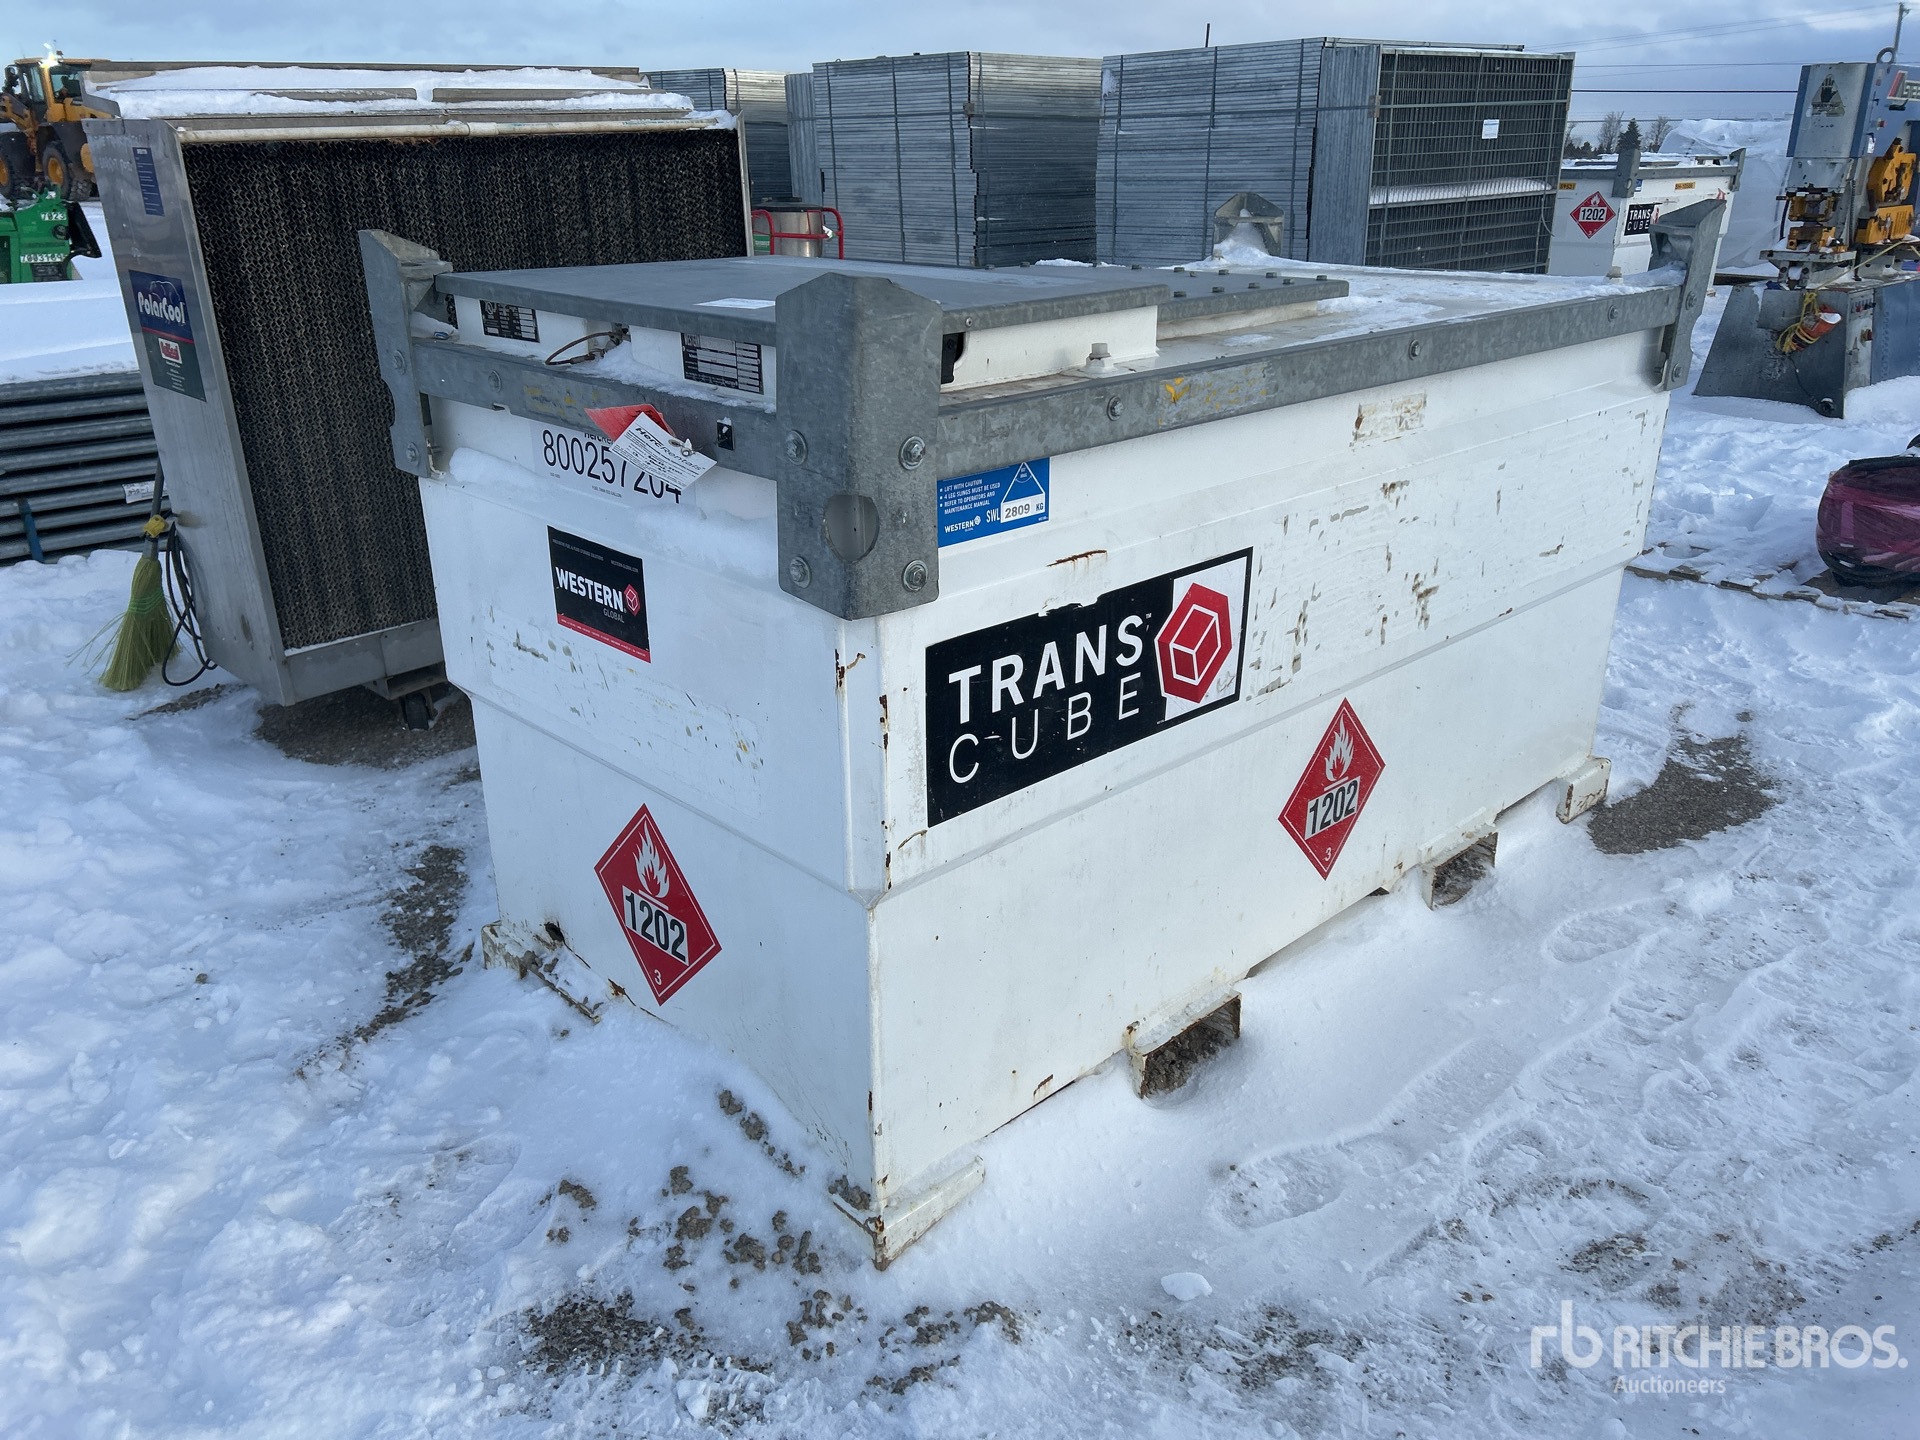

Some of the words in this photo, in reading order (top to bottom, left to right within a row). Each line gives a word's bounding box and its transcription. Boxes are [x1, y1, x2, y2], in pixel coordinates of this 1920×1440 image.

[1581, 208, 1605, 221] 1202
[1630, 209, 1651, 220] TRANS
[1627, 220, 1650, 231] CUBE
[137, 291, 185, 324] PolarCool
[986, 508, 1000, 523] SWL
[1004, 503, 1031, 519] 2809
[1035, 502, 1044, 512] KG
[944, 519, 974, 533] WESTERN
[555, 566, 624, 613] WESTERN
[603, 608, 625, 624] GLOBAL
[949, 615, 1144, 724] TRANS
[949, 671, 1142, 784] CUBE
[1309, 779, 1359, 835] 1202
[1324, 847, 1332, 862] 3
[625, 892, 686, 963] 1202
[653, 968, 663, 986] 3
